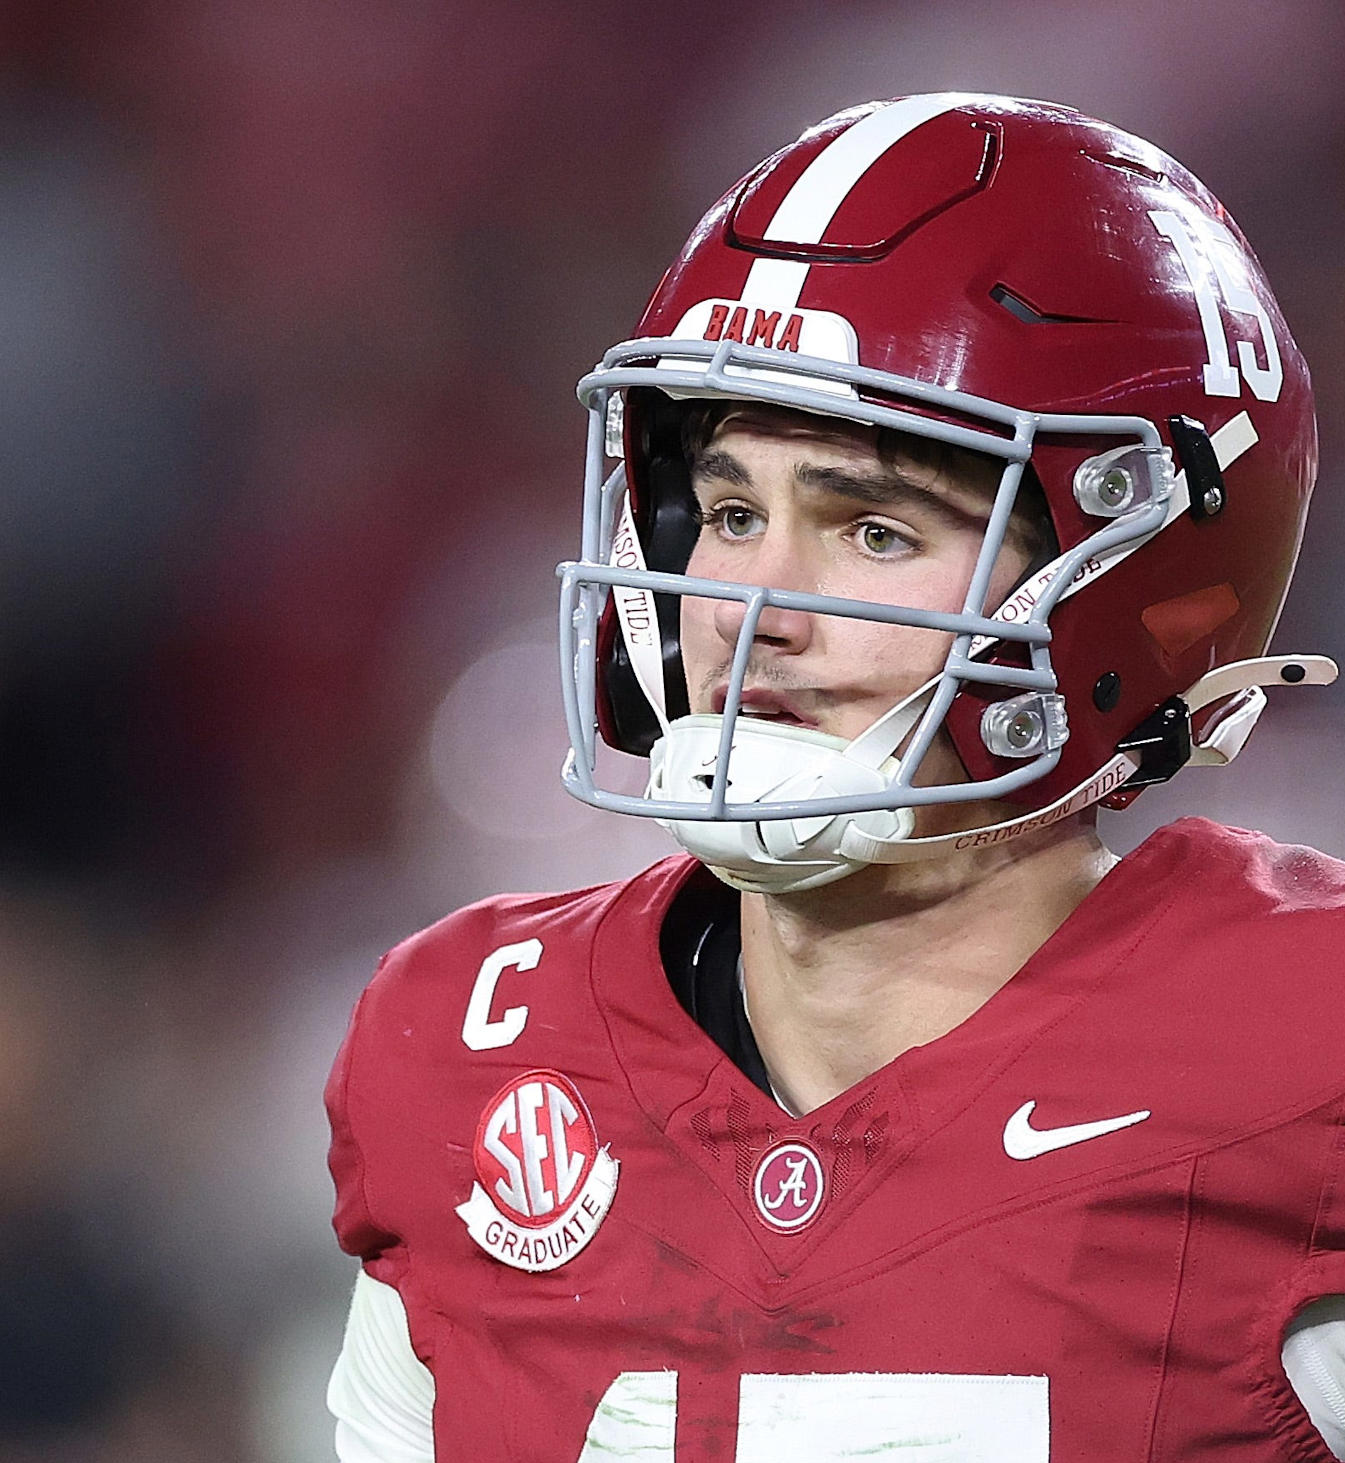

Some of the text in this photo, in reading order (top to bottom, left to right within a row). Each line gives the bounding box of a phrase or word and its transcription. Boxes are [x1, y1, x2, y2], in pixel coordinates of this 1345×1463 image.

[703, 304, 799, 353] BAMA
[1147, 210, 1284, 403] 15
[955, 761, 1127, 850] CRIMSON TIDE
[461, 937, 544, 1051] C
[483, 1081, 586, 1218] SEC
[764, 1157, 808, 1209] A
[484, 1193, 601, 1265] GRADUATE
